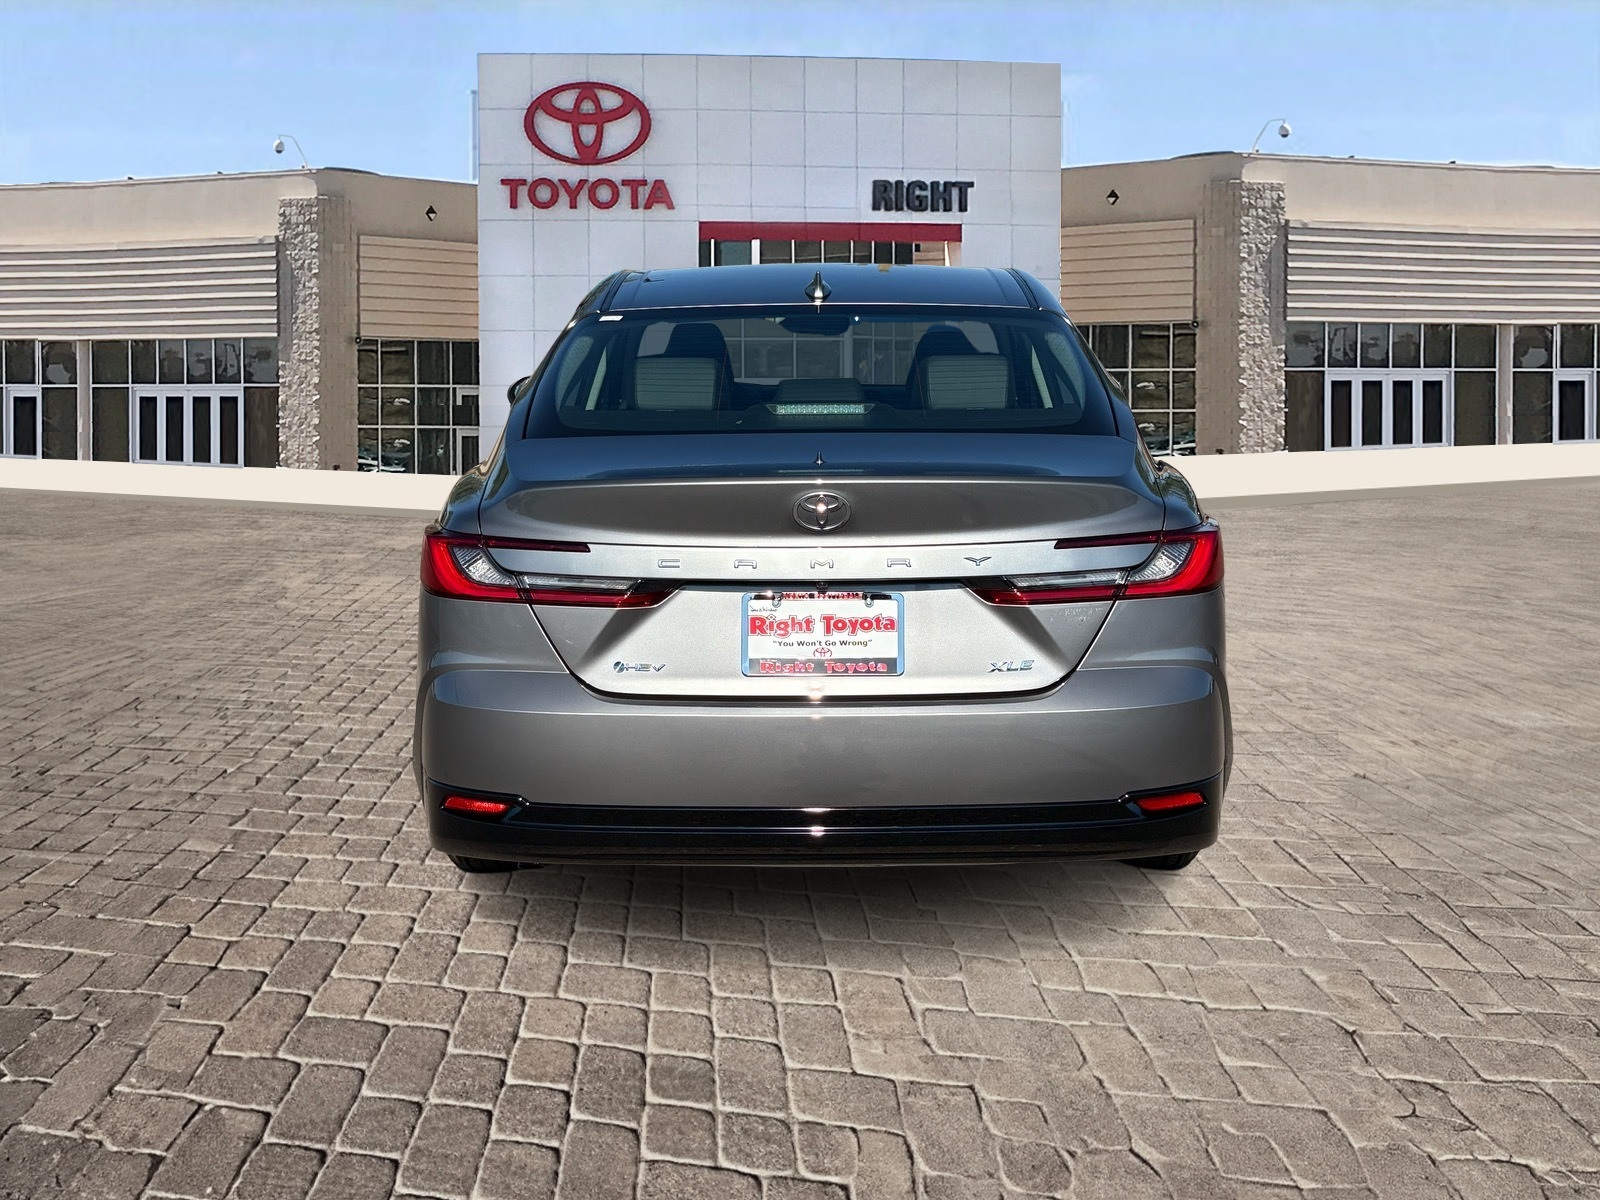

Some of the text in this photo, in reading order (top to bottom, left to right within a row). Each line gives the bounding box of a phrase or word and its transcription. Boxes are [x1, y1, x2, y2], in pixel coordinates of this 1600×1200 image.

[500, 177, 675, 210] TOYOTA
[871, 179, 975, 212] RIGHT
[657, 556, 992, 569] CAMRY
[748, 614, 898, 639] Right Toyota
[772, 639, 794, 648] "You
[796, 639, 823, 647] Won't
[839, 639, 873, 648] Wrong"
[625, 663, 666, 673] HEV
[759, 660, 888, 674] Right Toyota
[987, 659, 1035, 674] XLE
